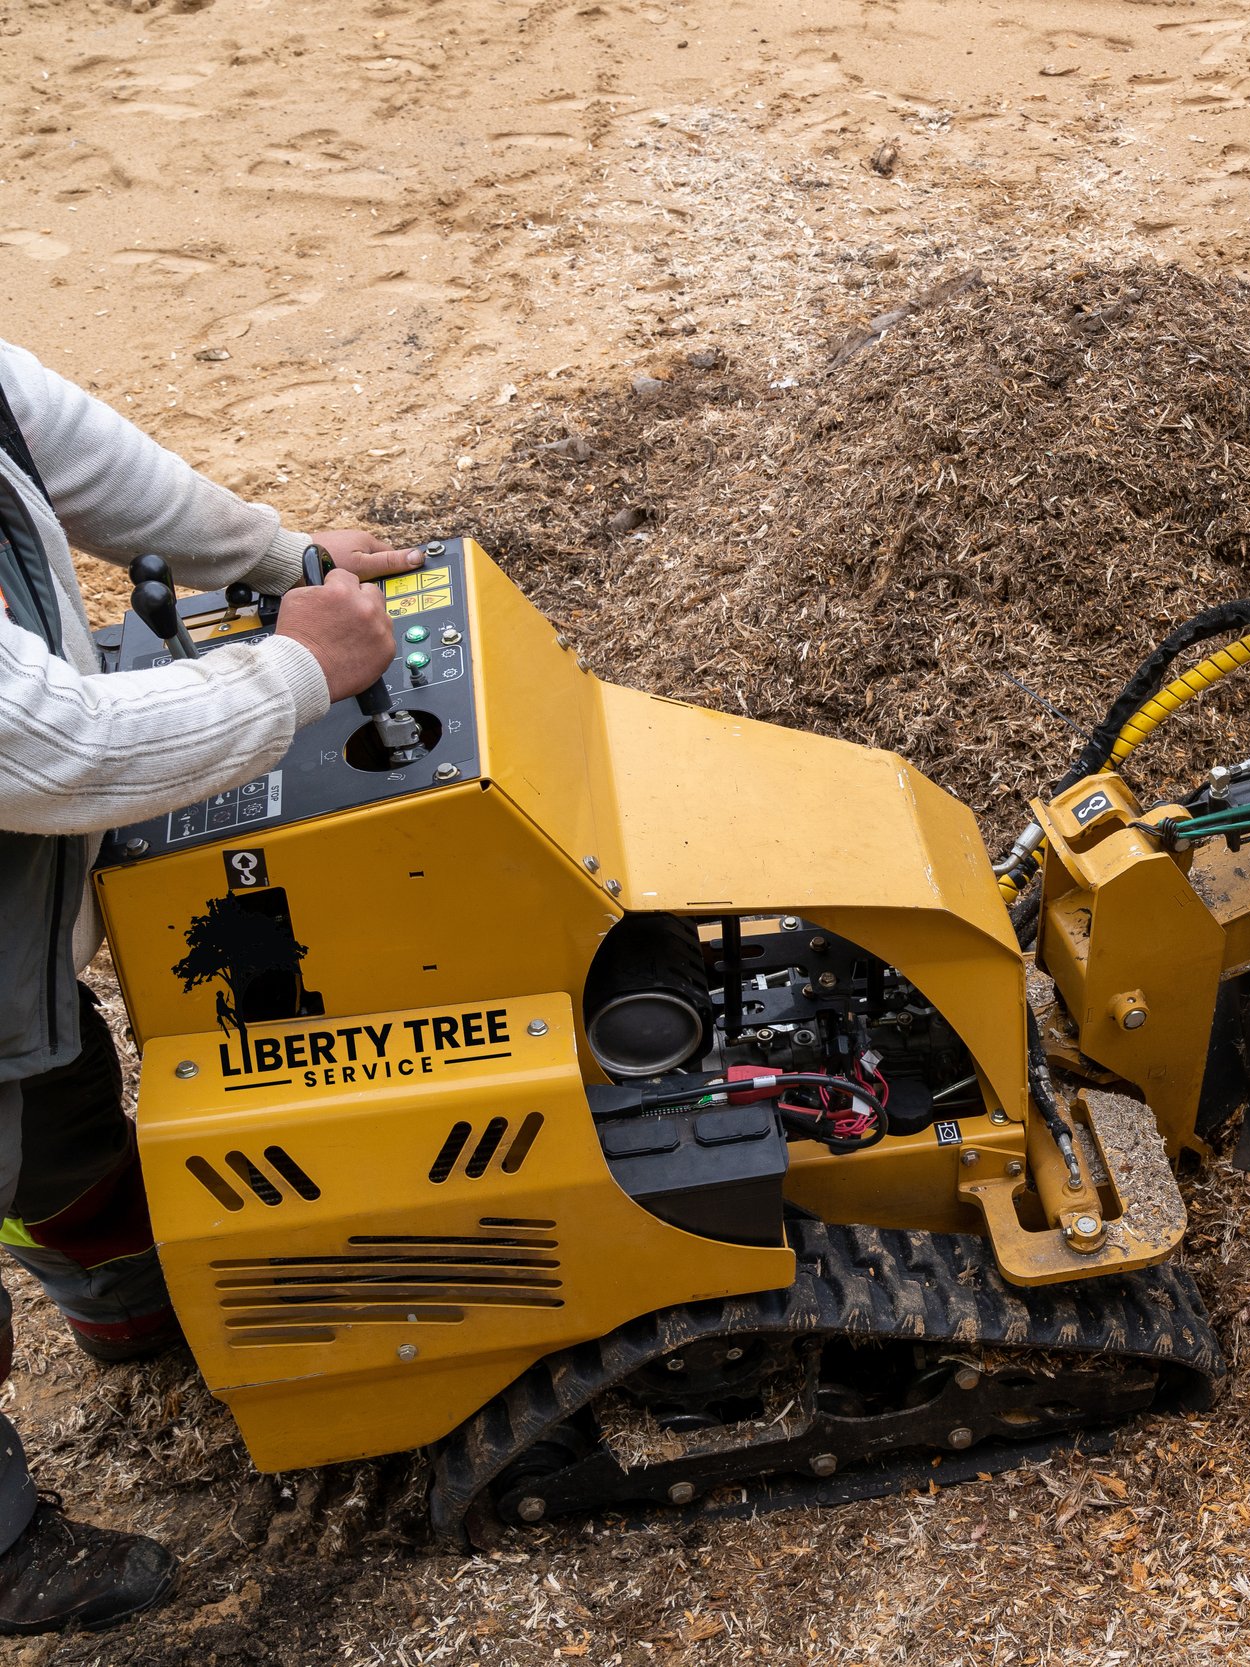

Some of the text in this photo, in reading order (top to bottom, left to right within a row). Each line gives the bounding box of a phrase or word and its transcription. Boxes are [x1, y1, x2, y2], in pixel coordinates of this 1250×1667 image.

[271, 785, 280, 801] STOP
[219, 1009, 510, 1076] LIBERTY TREE
[304, 1056, 433, 1087] SERVICE
